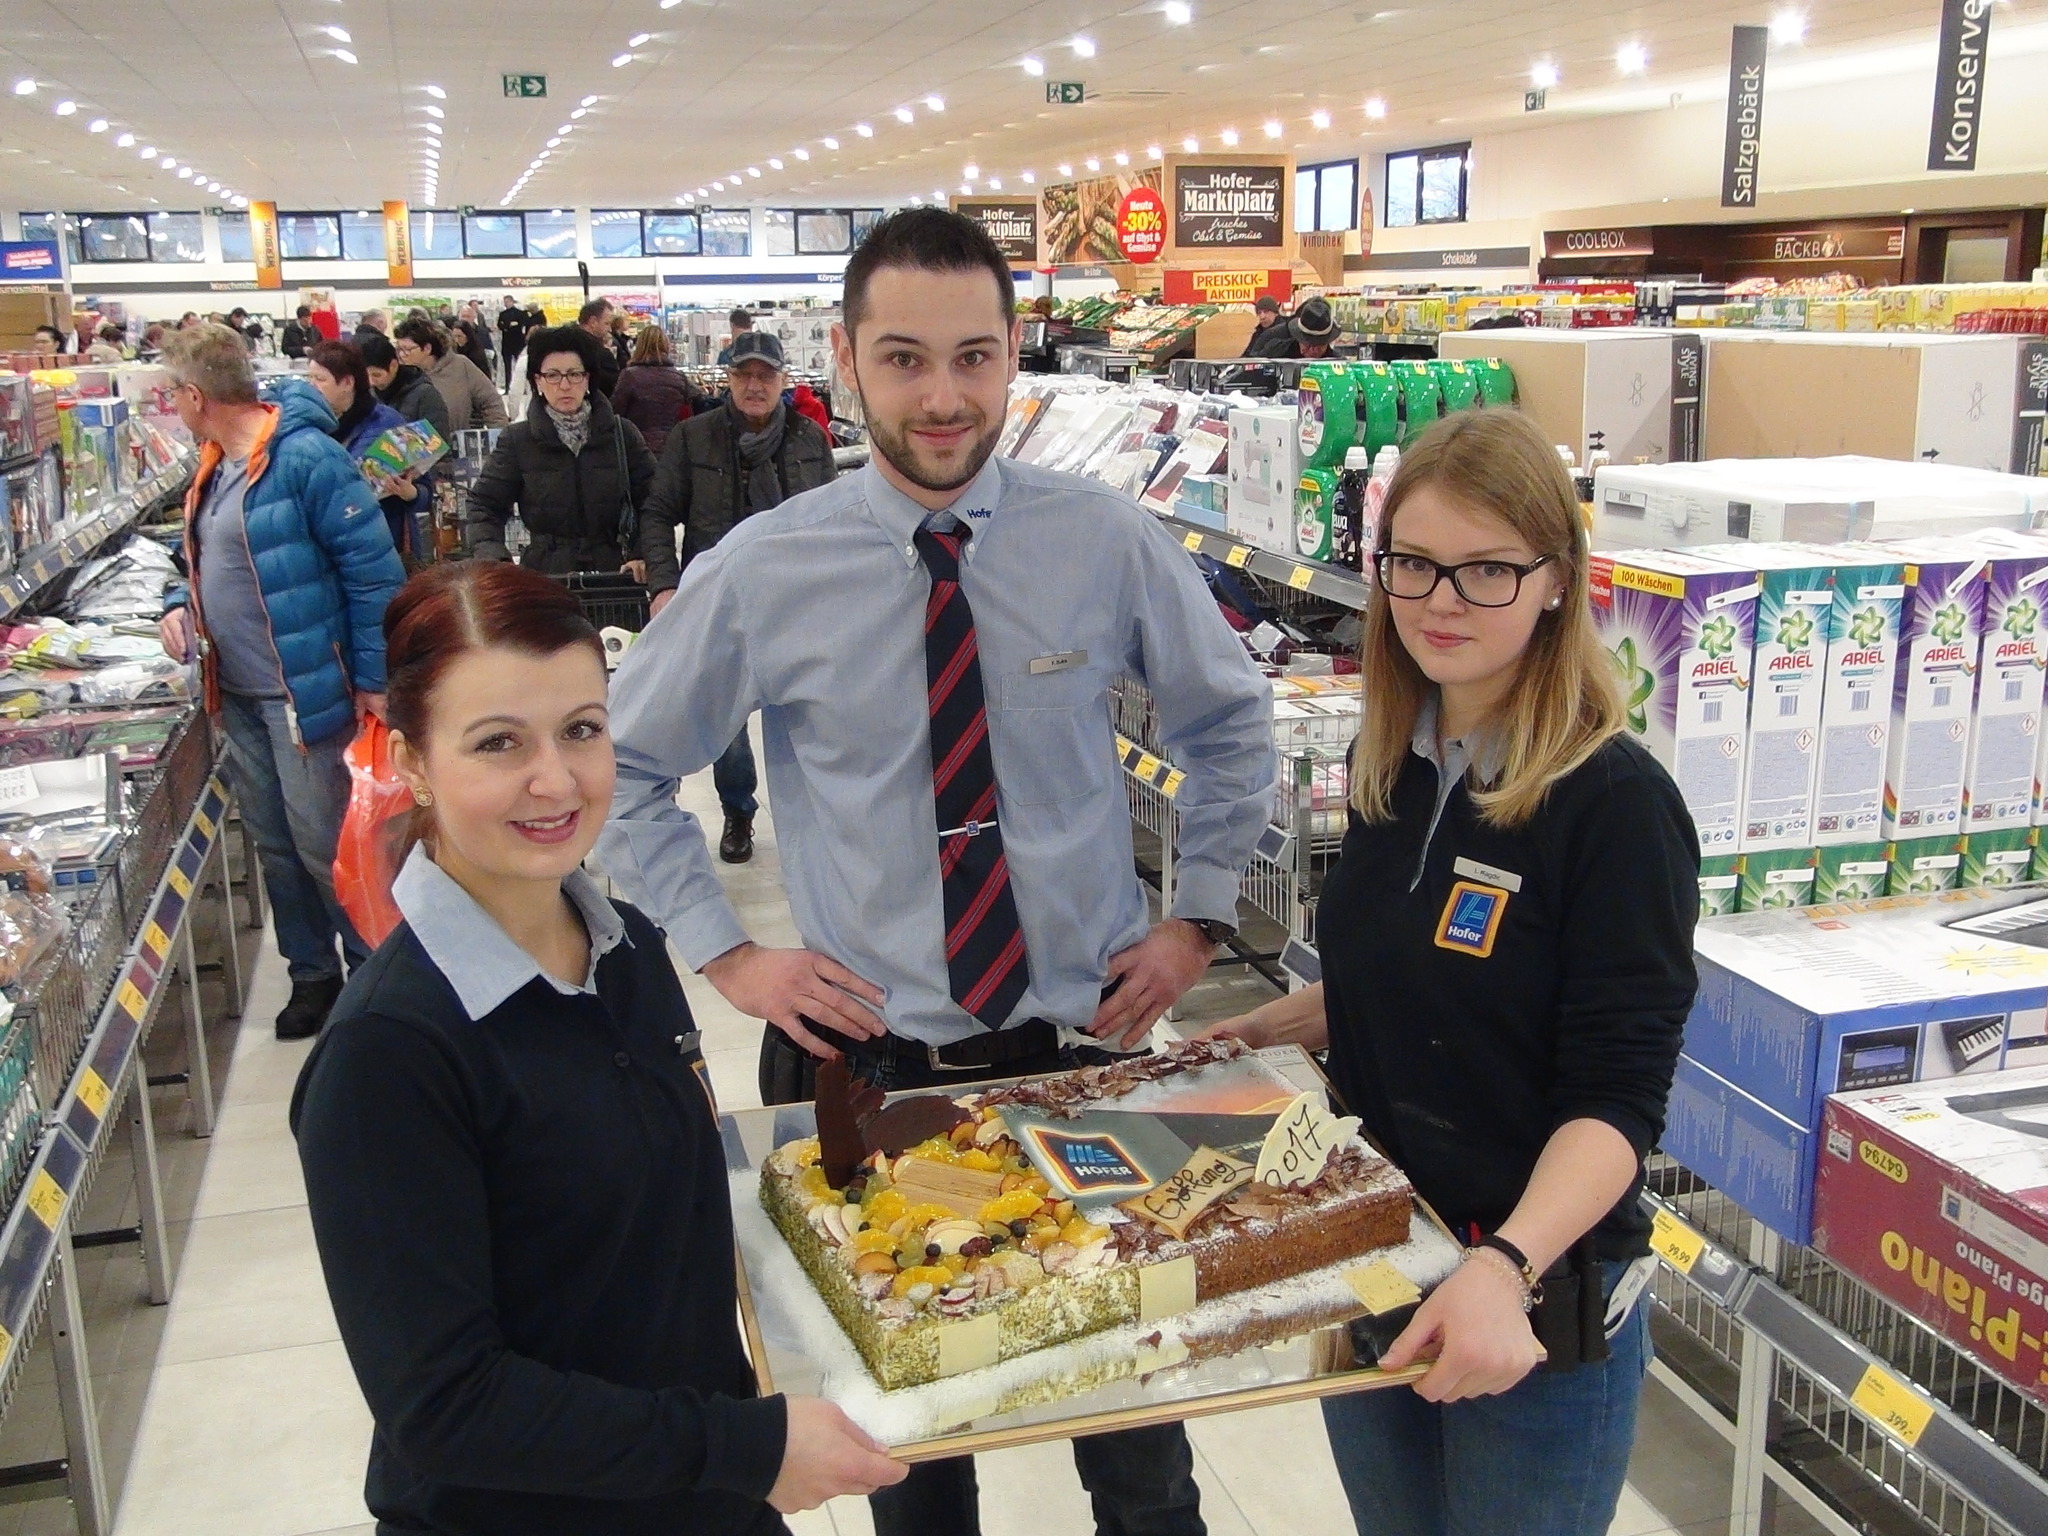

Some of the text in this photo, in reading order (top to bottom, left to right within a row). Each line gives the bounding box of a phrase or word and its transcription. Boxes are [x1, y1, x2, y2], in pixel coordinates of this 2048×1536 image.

[1945, 0, 1984, 162] Konserve
[1733, 65, 1760, 203] Salzgebäck
[1210, 173, 1253, 189] Hofer
[1130, 201, 1154, 211] Heute
[1184, 190, 1275, 216] Marktplatz
[982, 208, 1015, 220] Hofer
[1122, 211, 1162, 231] -30%
[1192, 229, 1263, 242] Obst & Gemüse
[1567, 231, 1626, 250] COOLBOX
[1442, 251, 1478, 265] Schokolade
[501, 277, 542, 287] WC-Papier
[817, 273, 843, 283] Körper
[1197, 273, 1263, 287] PREISKICK-
[1210, 289, 1251, 300] AKTION
[1621, 571, 1673, 592] 100 Wäschen
[1923, 647, 1967, 663] ARIEL
[1995, 642, 2037, 658] ARIEL
[1768, 655, 1814, 671] ARIEL
[1841, 651, 1885, 666] ARIEL
[1692, 661, 1738, 677] ARIEL
[1447, 925, 1482, 942] Hofer
[1864, 1145, 1903, 1178] 64794
[1074, 1166, 1132, 1176] HOFER
[1955, 1241, 2013, 1293] Piano
